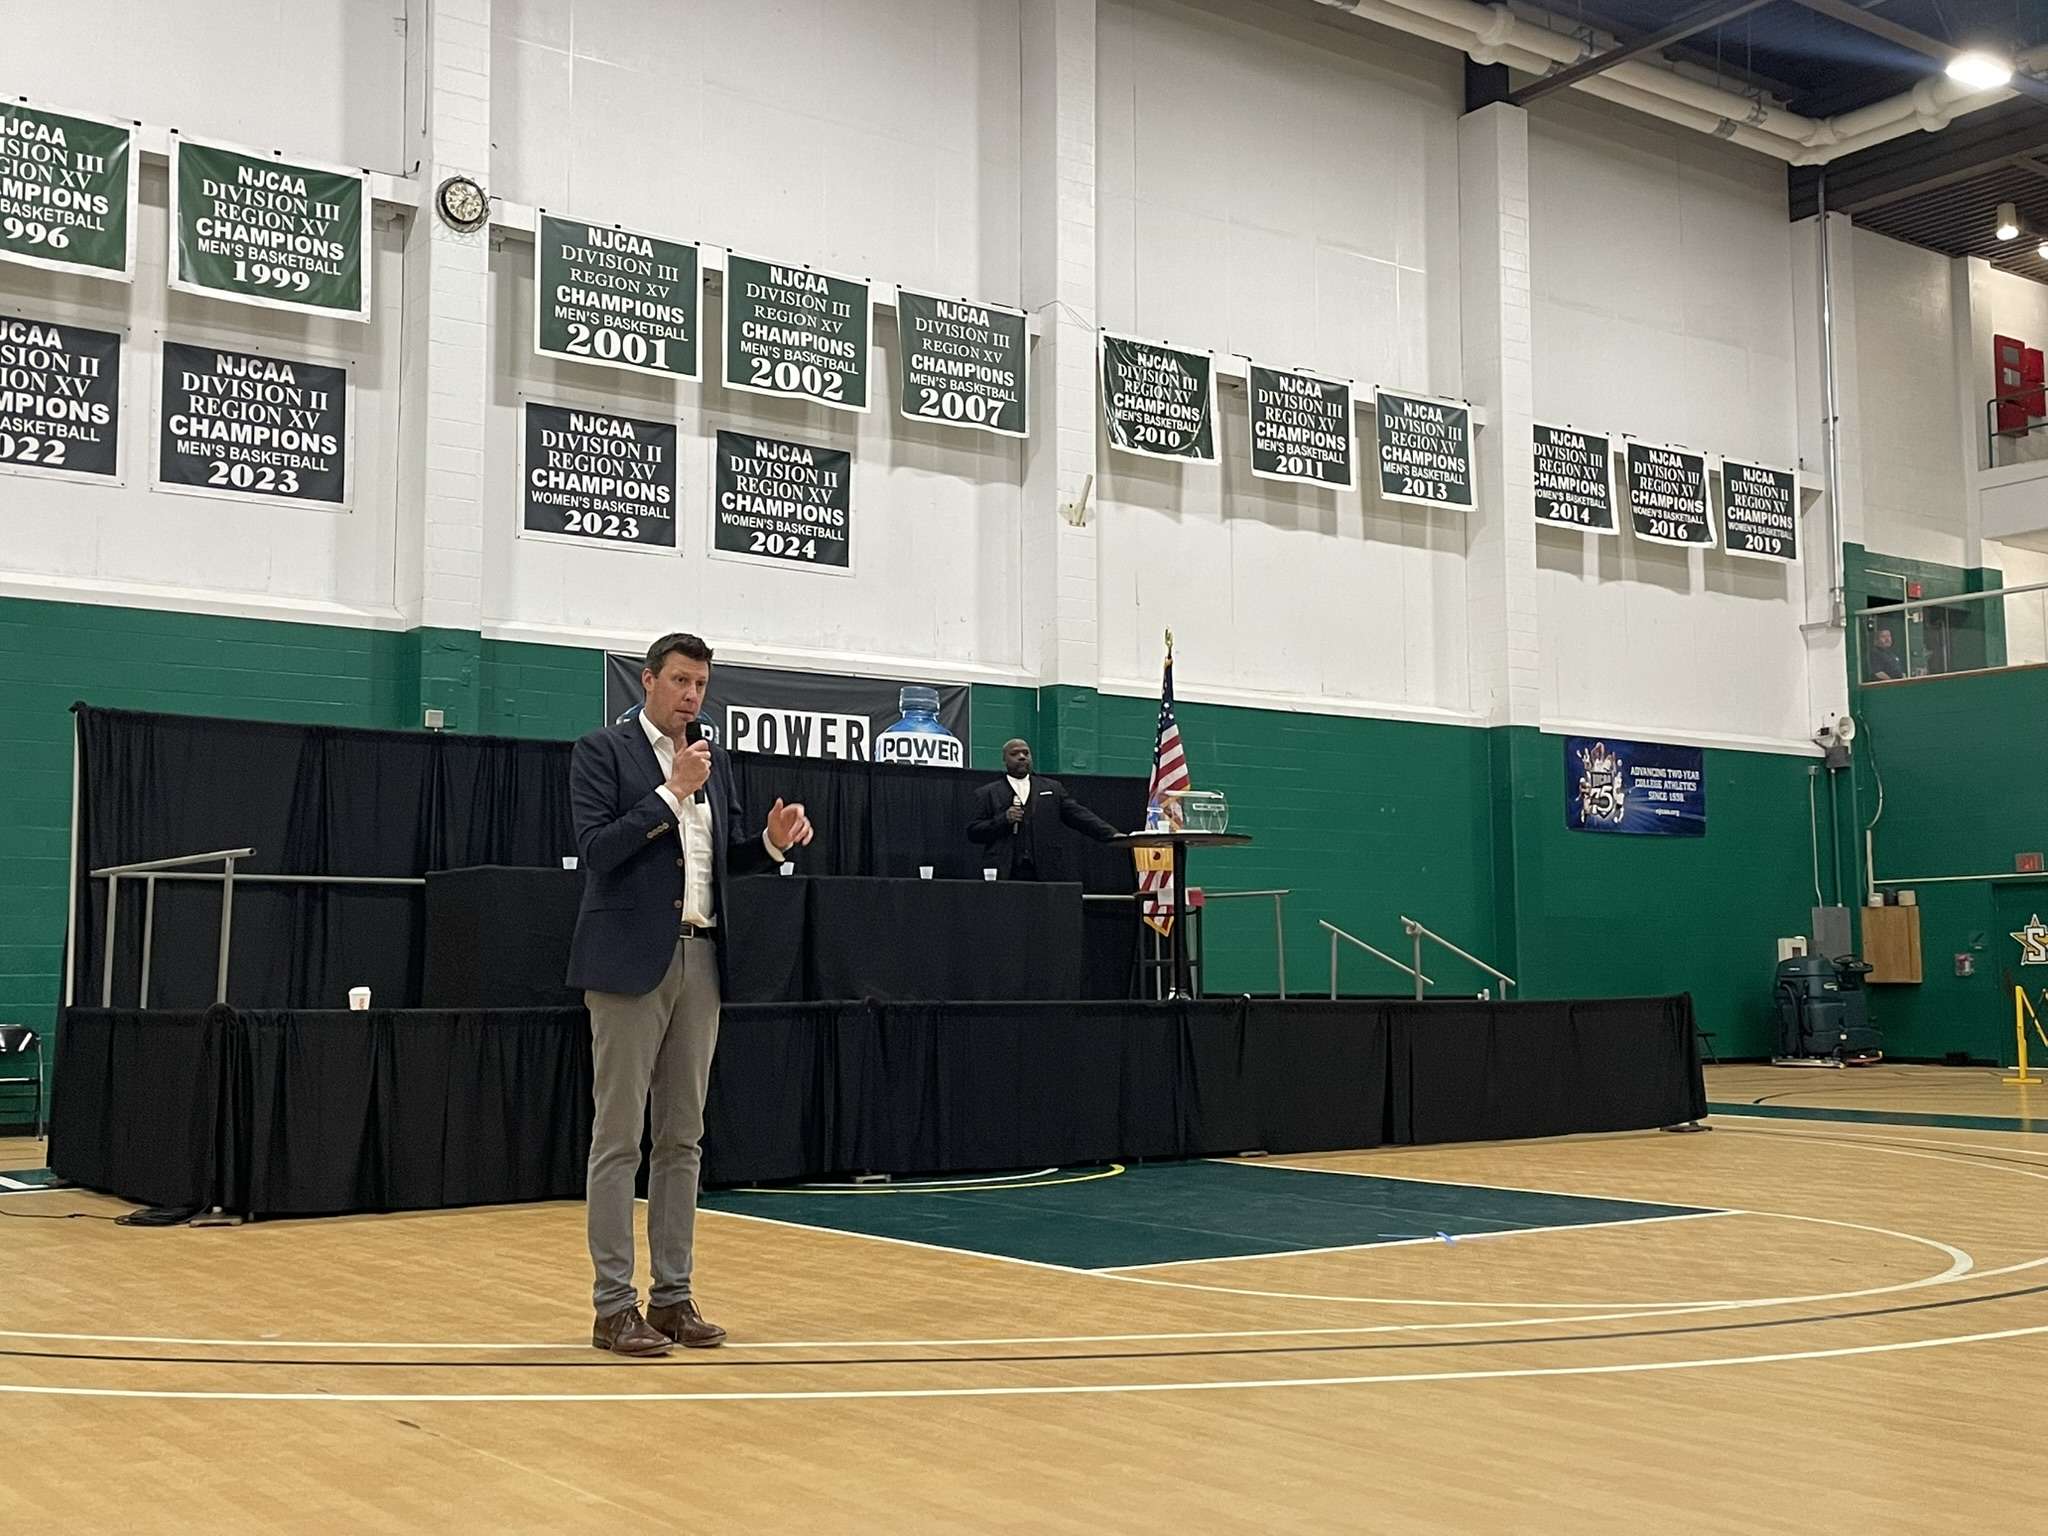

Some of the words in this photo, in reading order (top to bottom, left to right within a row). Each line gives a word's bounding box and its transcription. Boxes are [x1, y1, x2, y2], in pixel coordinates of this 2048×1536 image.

[0, 137, 68, 167] ISION
[77, 153, 104, 173] III
[0, 157, 53, 183] GION
[60, 169, 91, 189] XV
[238, 166, 307, 196] NJCAA
[0, 178, 109, 214] MPIONS
[203, 179, 308, 216] DIVISION
[316, 202, 340, 221] III
[0, 199, 105, 231] BASKETBALL
[214, 200, 295, 232] REGION
[300, 217, 330, 236] XV
[3, 217, 69, 248] 996
[196, 217, 344, 260] CHAMPIONS
[588, 227, 654, 258] NJCAA
[198, 238, 244, 257] MEN'S
[249, 247, 342, 275] BASKETBALL
[561, 245, 652, 277] DIVISION
[658, 264, 679, 282] III
[233, 260, 310, 291] 1999
[570, 268, 640, 293] REGION
[646, 283, 670, 298] XV
[770, 266, 829, 295] NJCAA
[557, 285, 685, 324] CHAMPIONS
[746, 283, 827, 312] DIVISION
[832, 301, 850, 318] III
[937, 301, 990, 327] NJCAA
[555, 305, 599, 325] MEN'S
[604, 315, 688, 341] BASKETBALL
[754, 305, 817, 328] REGION
[821, 319, 843, 334] XV
[915, 317, 988, 344] DIVISION
[993, 333, 1010, 348] III
[0, 320, 62, 349] JCAA
[566, 323, 670, 369] 2001
[742, 321, 855, 358] CHAMPIONS
[0, 345, 70, 373] SION
[79, 356, 100, 377] II
[741, 341, 780, 358] MEN'S
[784, 349, 859, 375] BASKETBALL
[922, 338, 979, 359] REGION
[983, 350, 1003, 363] XV
[1138, 352, 1178, 373] NJCAA
[0, 367, 47, 392] ION
[55, 375, 91, 397] XV
[217, 354, 295, 385] NJCAA
[750, 357, 843, 401] 2002
[912, 354, 1015, 386] CHAMPIONS
[1118, 364, 1179, 389] DIVISION
[1183, 376, 1198, 391] III
[182, 372, 303, 407] DIVISION
[310, 390, 328, 410] II
[910, 372, 947, 389] MEN'S
[950, 380, 1018, 402] BASKETBALL
[1125, 379, 1171, 400] REGION
[1175, 389, 1191, 403] XV
[1280, 376, 1322, 398] NJCAA
[0, 391, 110, 424] MPIONS
[189, 394, 282, 425] REGION
[288, 409, 320, 430] XV
[919, 388, 1005, 426] 2007
[1113, 393, 1200, 421] CHAMPIONS
[1259, 389, 1323, 415] DIVISION
[1327, 403, 1343, 418] III
[1404, 402, 1443, 423] NJCAA
[0, 416, 100, 441] ASKETBALL
[570, 413, 635, 440] NJCAA
[1115, 408, 1142, 423] MEN'S
[1145, 413, 1198, 433] BASKETBALL
[1266, 406, 1315, 428] REGION
[1319, 417, 1336, 432] XV
[1384, 414, 1444, 437] DIVISION
[1448, 426, 1462, 441] III
[0, 433, 66, 465] 022
[169, 415, 337, 455] CHAMPIONS
[541, 430, 641, 460] DIVISION
[647, 445, 662, 462] II
[1134, 425, 1180, 447] 2010
[1255, 421, 1346, 451] CHAMPIONS
[1391, 431, 1437, 452] REGION
[1440, 440, 1456, 454] XV
[1550, 430, 1586, 450] NJCAA
[177, 440, 225, 458] MEN'S
[230, 447, 328, 471] BASKETBALL
[549, 450, 624, 477] REGION
[630, 462, 656, 480] XV
[756, 441, 813, 466] NJCAA
[1257, 438, 1284, 453] MEN'S
[1287, 444, 1344, 464] BASKETBALL
[1382, 445, 1465, 472] CHAMPIONS
[1534, 443, 1587, 464] DIVISION
[1590, 453, 1603, 468] III
[1649, 450, 1683, 469] NJCAA
[208, 461, 299, 493] 2023
[731, 456, 818, 485] DIVISION
[824, 471, 838, 487] II
[1276, 455, 1324, 479] 2011
[1383, 462, 1410, 475] MEN'S
[1412, 466, 1464, 485] BASKETBALL
[1539, 458, 1581, 477] REGION
[1583, 466, 1598, 480] XV
[1634, 462, 1685, 482] DIVISION
[1687, 472, 1699, 484] III
[1743, 468, 1775, 485] NJCAA
[532, 468, 670, 503] CHAMPIONS
[736, 475, 803, 501] REGION
[809, 487, 832, 504] XV
[1402, 477, 1447, 500] 2013
[1534, 472, 1605, 497] CHAMPIONS
[1535, 489, 1564, 501] OMEN'S
[1566, 493, 1606, 509] BASKETBALL
[1640, 476, 1679, 495] REGION
[1682, 484, 1695, 498] XV
[1731, 480, 1778, 499] DIVISION
[1781, 489, 1788, 501] II
[532, 490, 590, 509] WOMEN'S
[594, 499, 670, 519] BASKETBALL
[722, 492, 844, 526] CHAMPIONS
[1549, 502, 1589, 523] 2014
[1632, 490, 1704, 513] CHAMPIONS
[1735, 494, 1771, 511] REGION
[1773, 500, 1787, 513] XV
[564, 510, 639, 539] 2023
[722, 513, 773, 530] WOMEN'S
[777, 521, 844, 541] BASKETBALL
[1650, 519, 1687, 539] 2016
[1664, 510, 1704, 524] BASKETBALL
[1728, 506, 1793, 529] CHAMPIONS
[750, 531, 816, 559] 2024
[1745, 534, 1781, 553] 2019
[732, 711, 866, 760] POWER
[884, 738, 958, 762] POWER
[1631, 767, 1666, 777] ADVANCING
[1635, 779, 1662, 789] COLLEGE
[1664, 781, 1696, 791] ATHLETICS
[1649, 791, 1667, 801] SINCE
